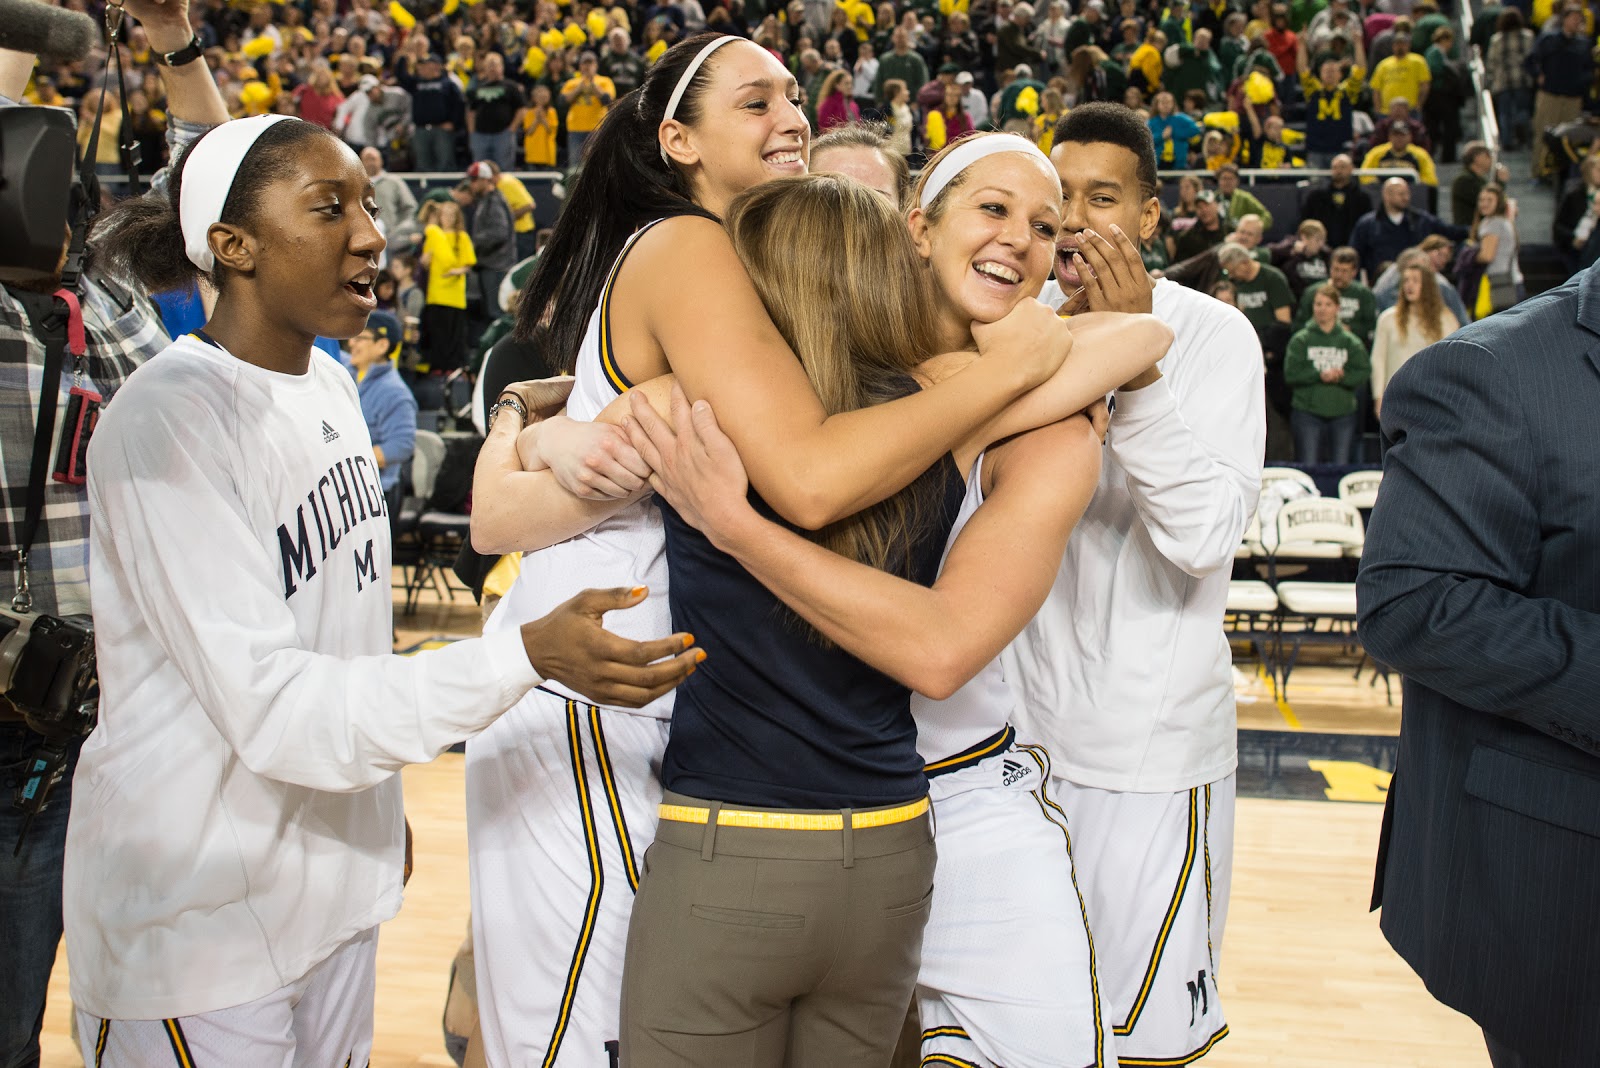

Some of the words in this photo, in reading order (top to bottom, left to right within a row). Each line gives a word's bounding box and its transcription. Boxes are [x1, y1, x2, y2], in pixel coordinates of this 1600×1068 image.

[1317, 97, 1342, 121] M
[1287, 508, 1354, 528] MICHIGAN
[354, 538, 377, 593] M
[1003, 766, 1032, 787] adidas
[1186, 969, 1208, 1028] M
